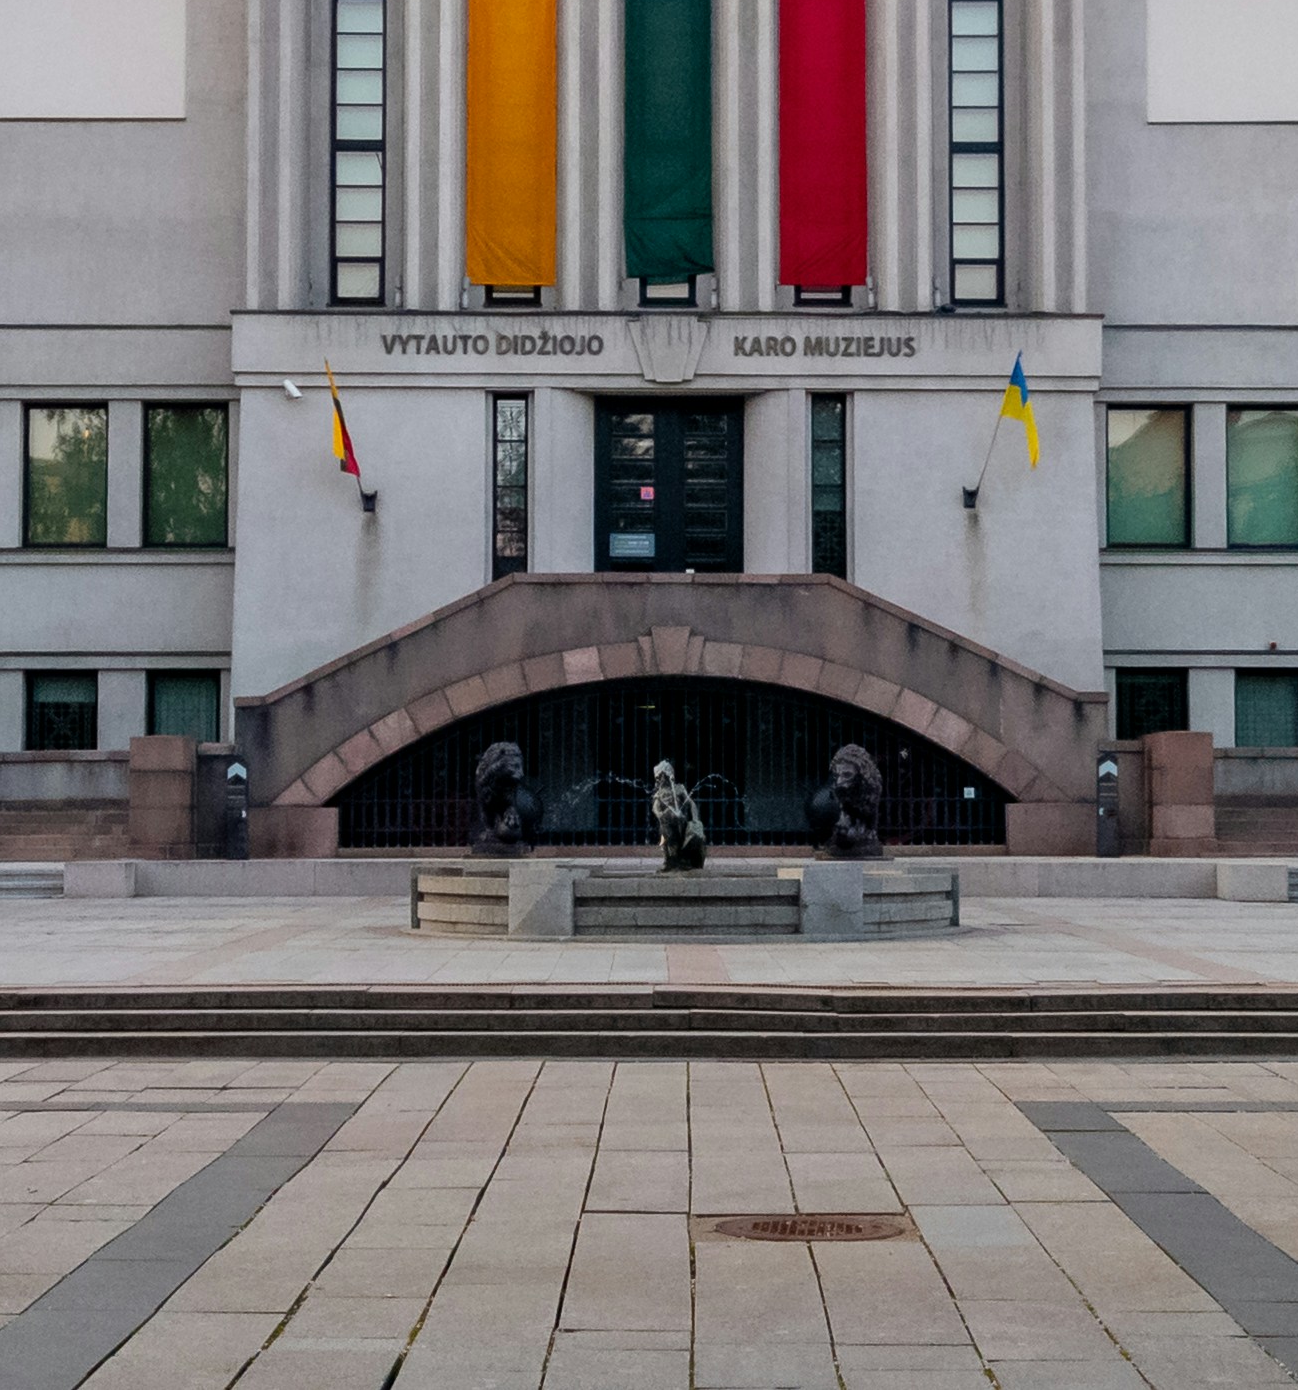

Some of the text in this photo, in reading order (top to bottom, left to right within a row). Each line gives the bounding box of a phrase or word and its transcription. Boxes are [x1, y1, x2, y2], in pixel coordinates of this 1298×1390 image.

[381, 330, 916, 358] VYTAUTO DIDŽIOJO KARO MUZIEJUS
